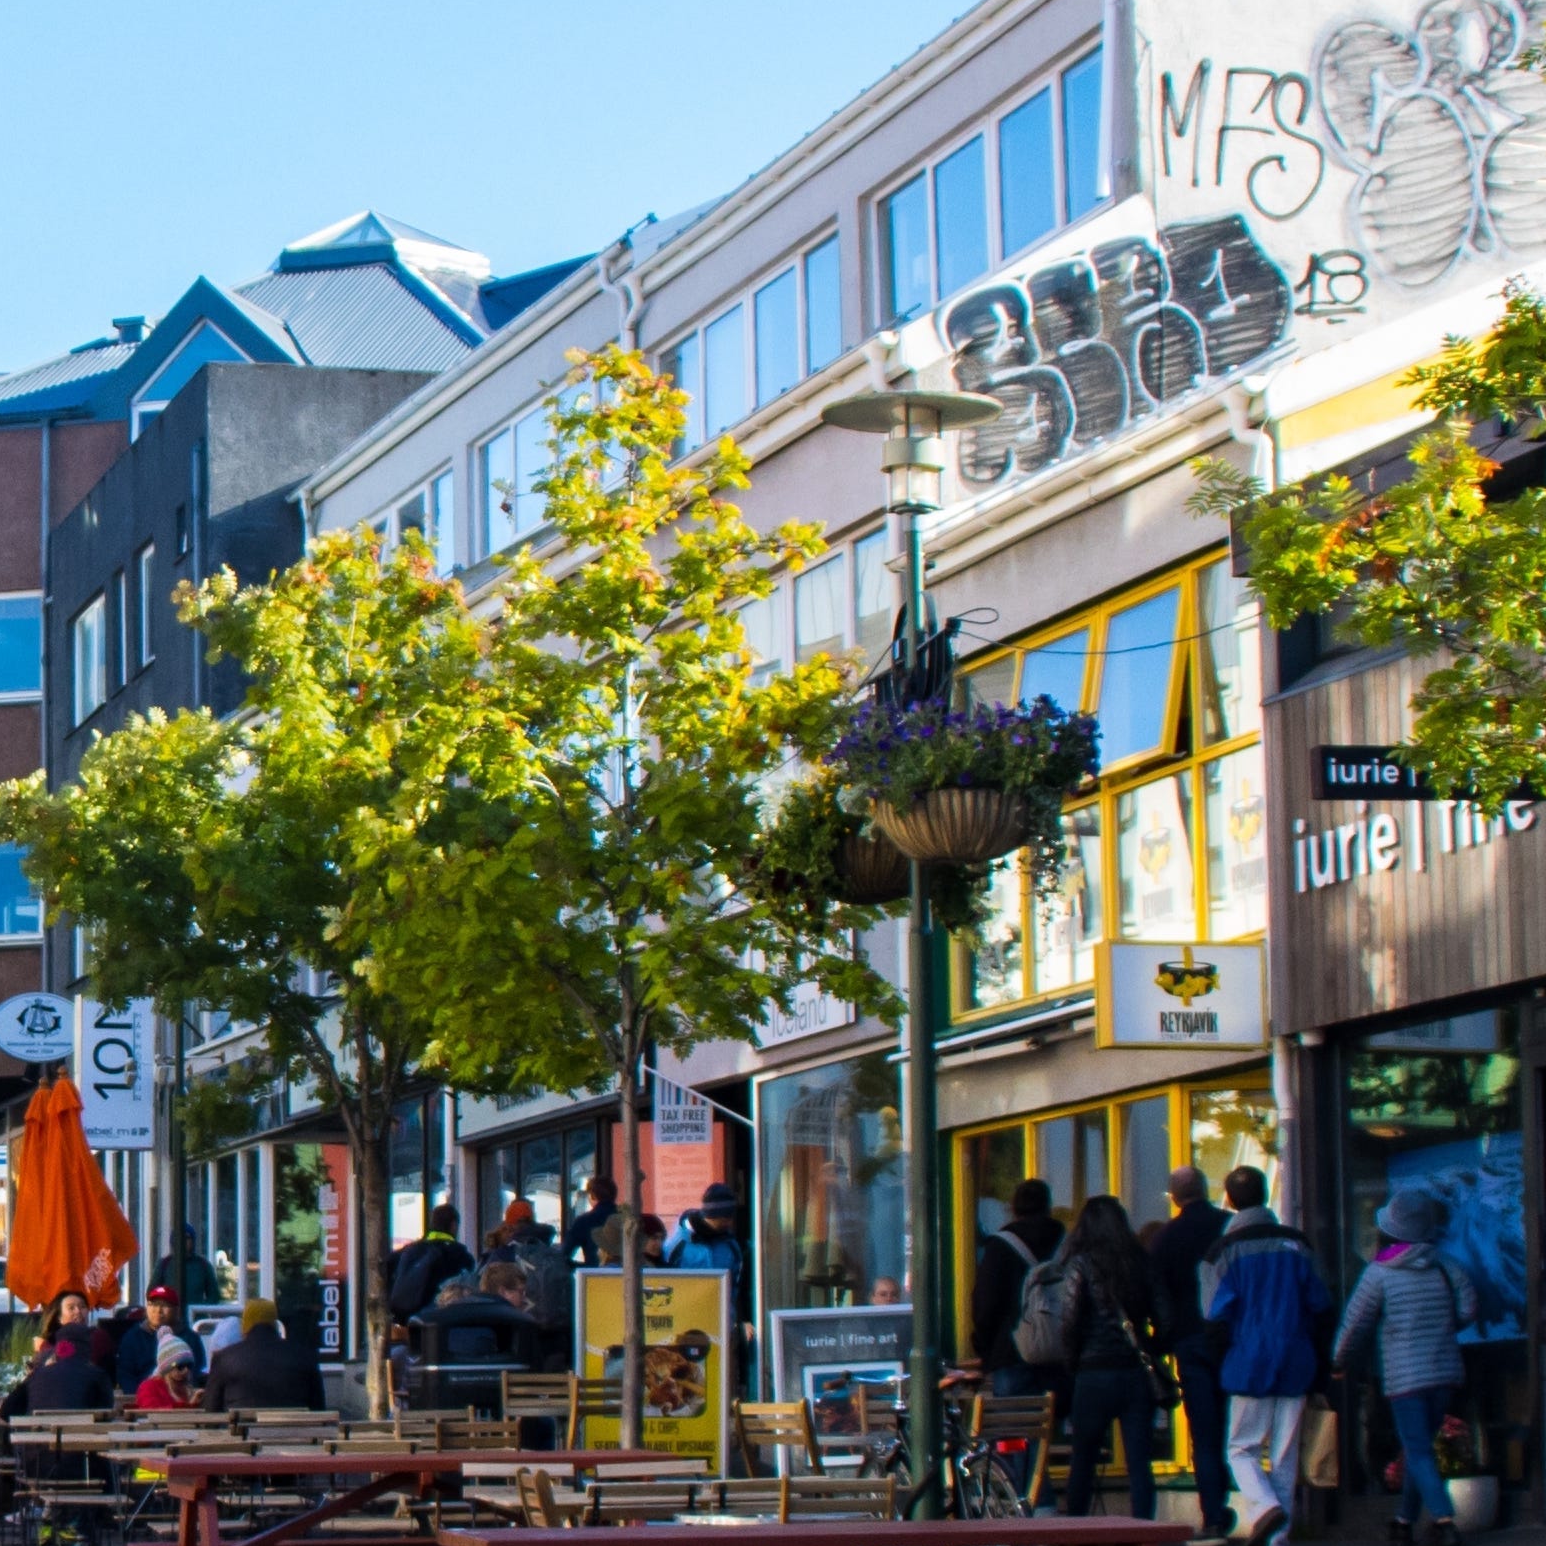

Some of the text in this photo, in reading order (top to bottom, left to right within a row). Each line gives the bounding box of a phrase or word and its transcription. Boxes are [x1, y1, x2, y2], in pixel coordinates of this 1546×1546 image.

[1329, 757, 1399, 784] iurie
[1294, 800, 1399, 893] iurie
[661, 1109, 706, 1121] TAX FREE
[661, 1122, 706, 1135] SHOPPING
[318, 1234, 340, 1355] label.m
[805, 1334, 837, 1348] iurie
[848, 1332, 876, 1346] fine
[878, 1331, 899, 1345] art
